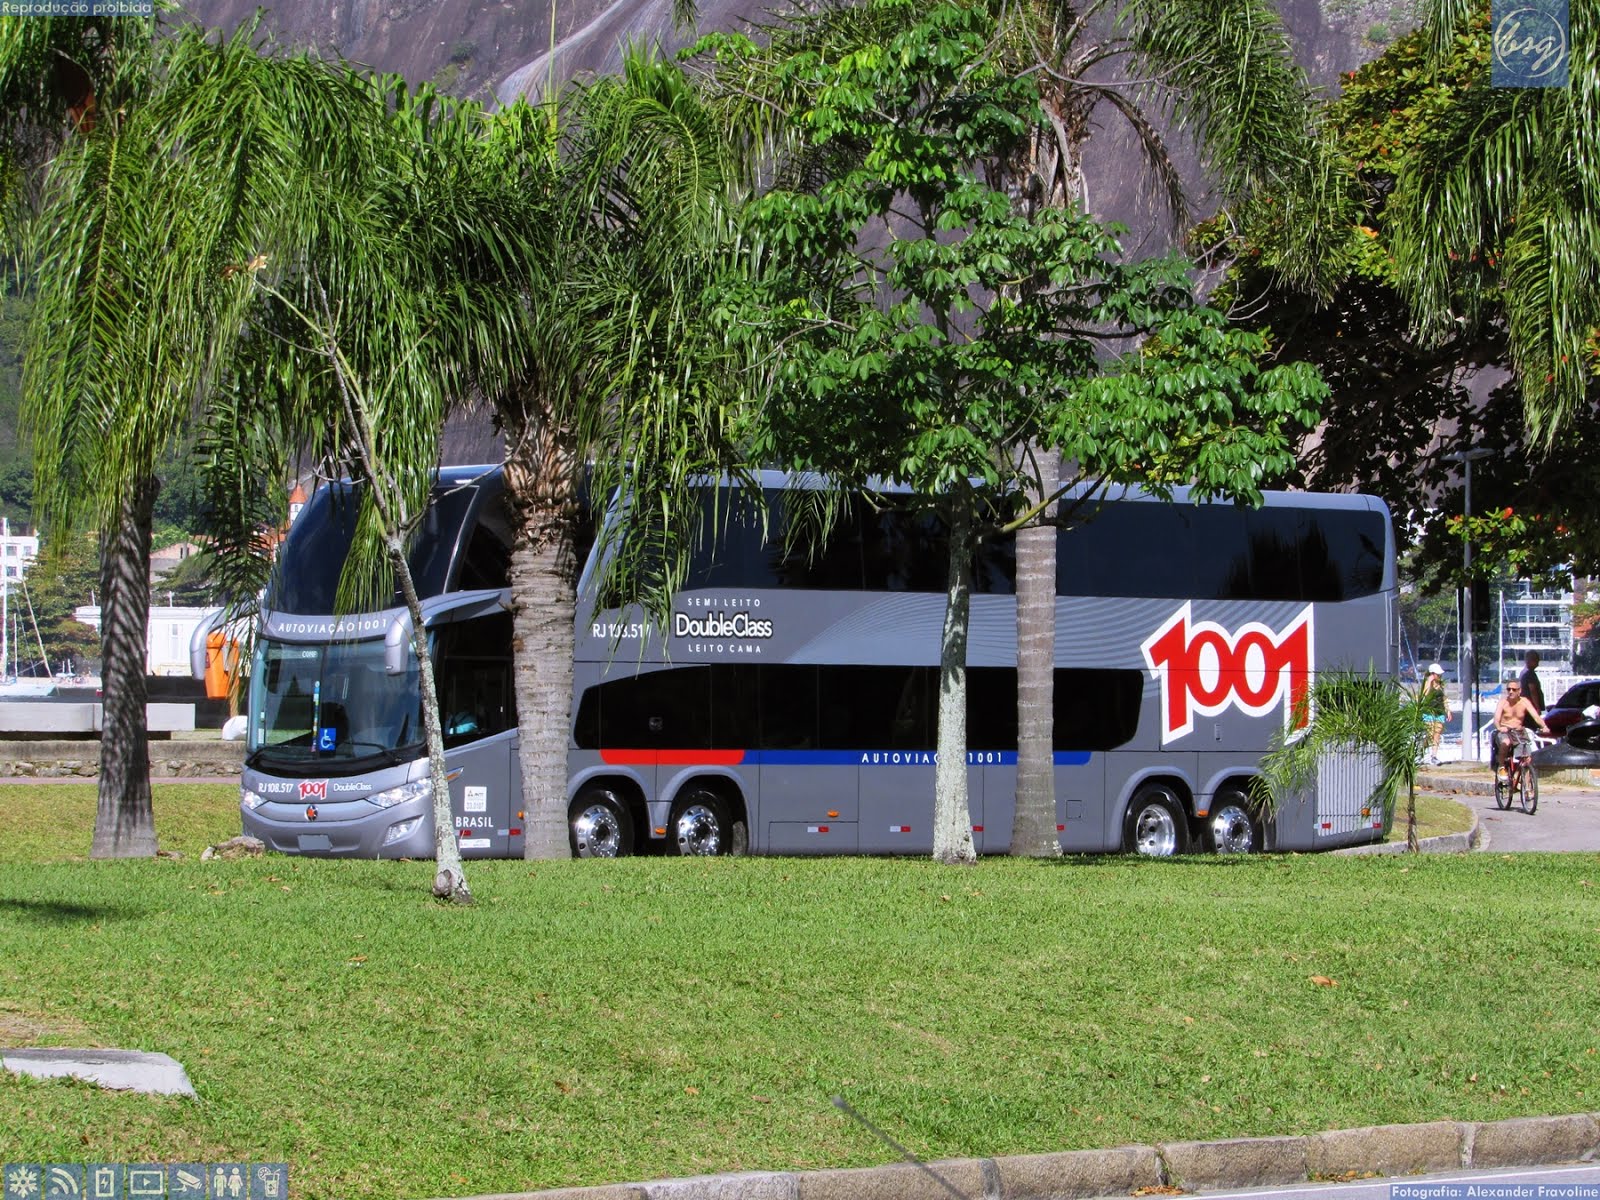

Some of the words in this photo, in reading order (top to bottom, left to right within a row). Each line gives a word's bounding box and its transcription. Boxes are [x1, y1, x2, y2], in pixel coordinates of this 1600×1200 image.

[687, 598, 717, 606] SEMI
[724, 598, 761, 607] LEITO
[592, 623, 606, 638] RJ
[675, 612, 773, 638] DoubleClass
[688, 644, 723, 653] LEITO
[729, 644, 761, 653] CAMA
[1140, 599, 1315, 746] 1001
[968, 752, 1001, 763] 1001
[258, 782, 267, 793] RJ
[298, 779, 329, 800] 1001
[333, 782, 372, 792] DoubleClass
[455, 816, 494, 828] BRASIL
